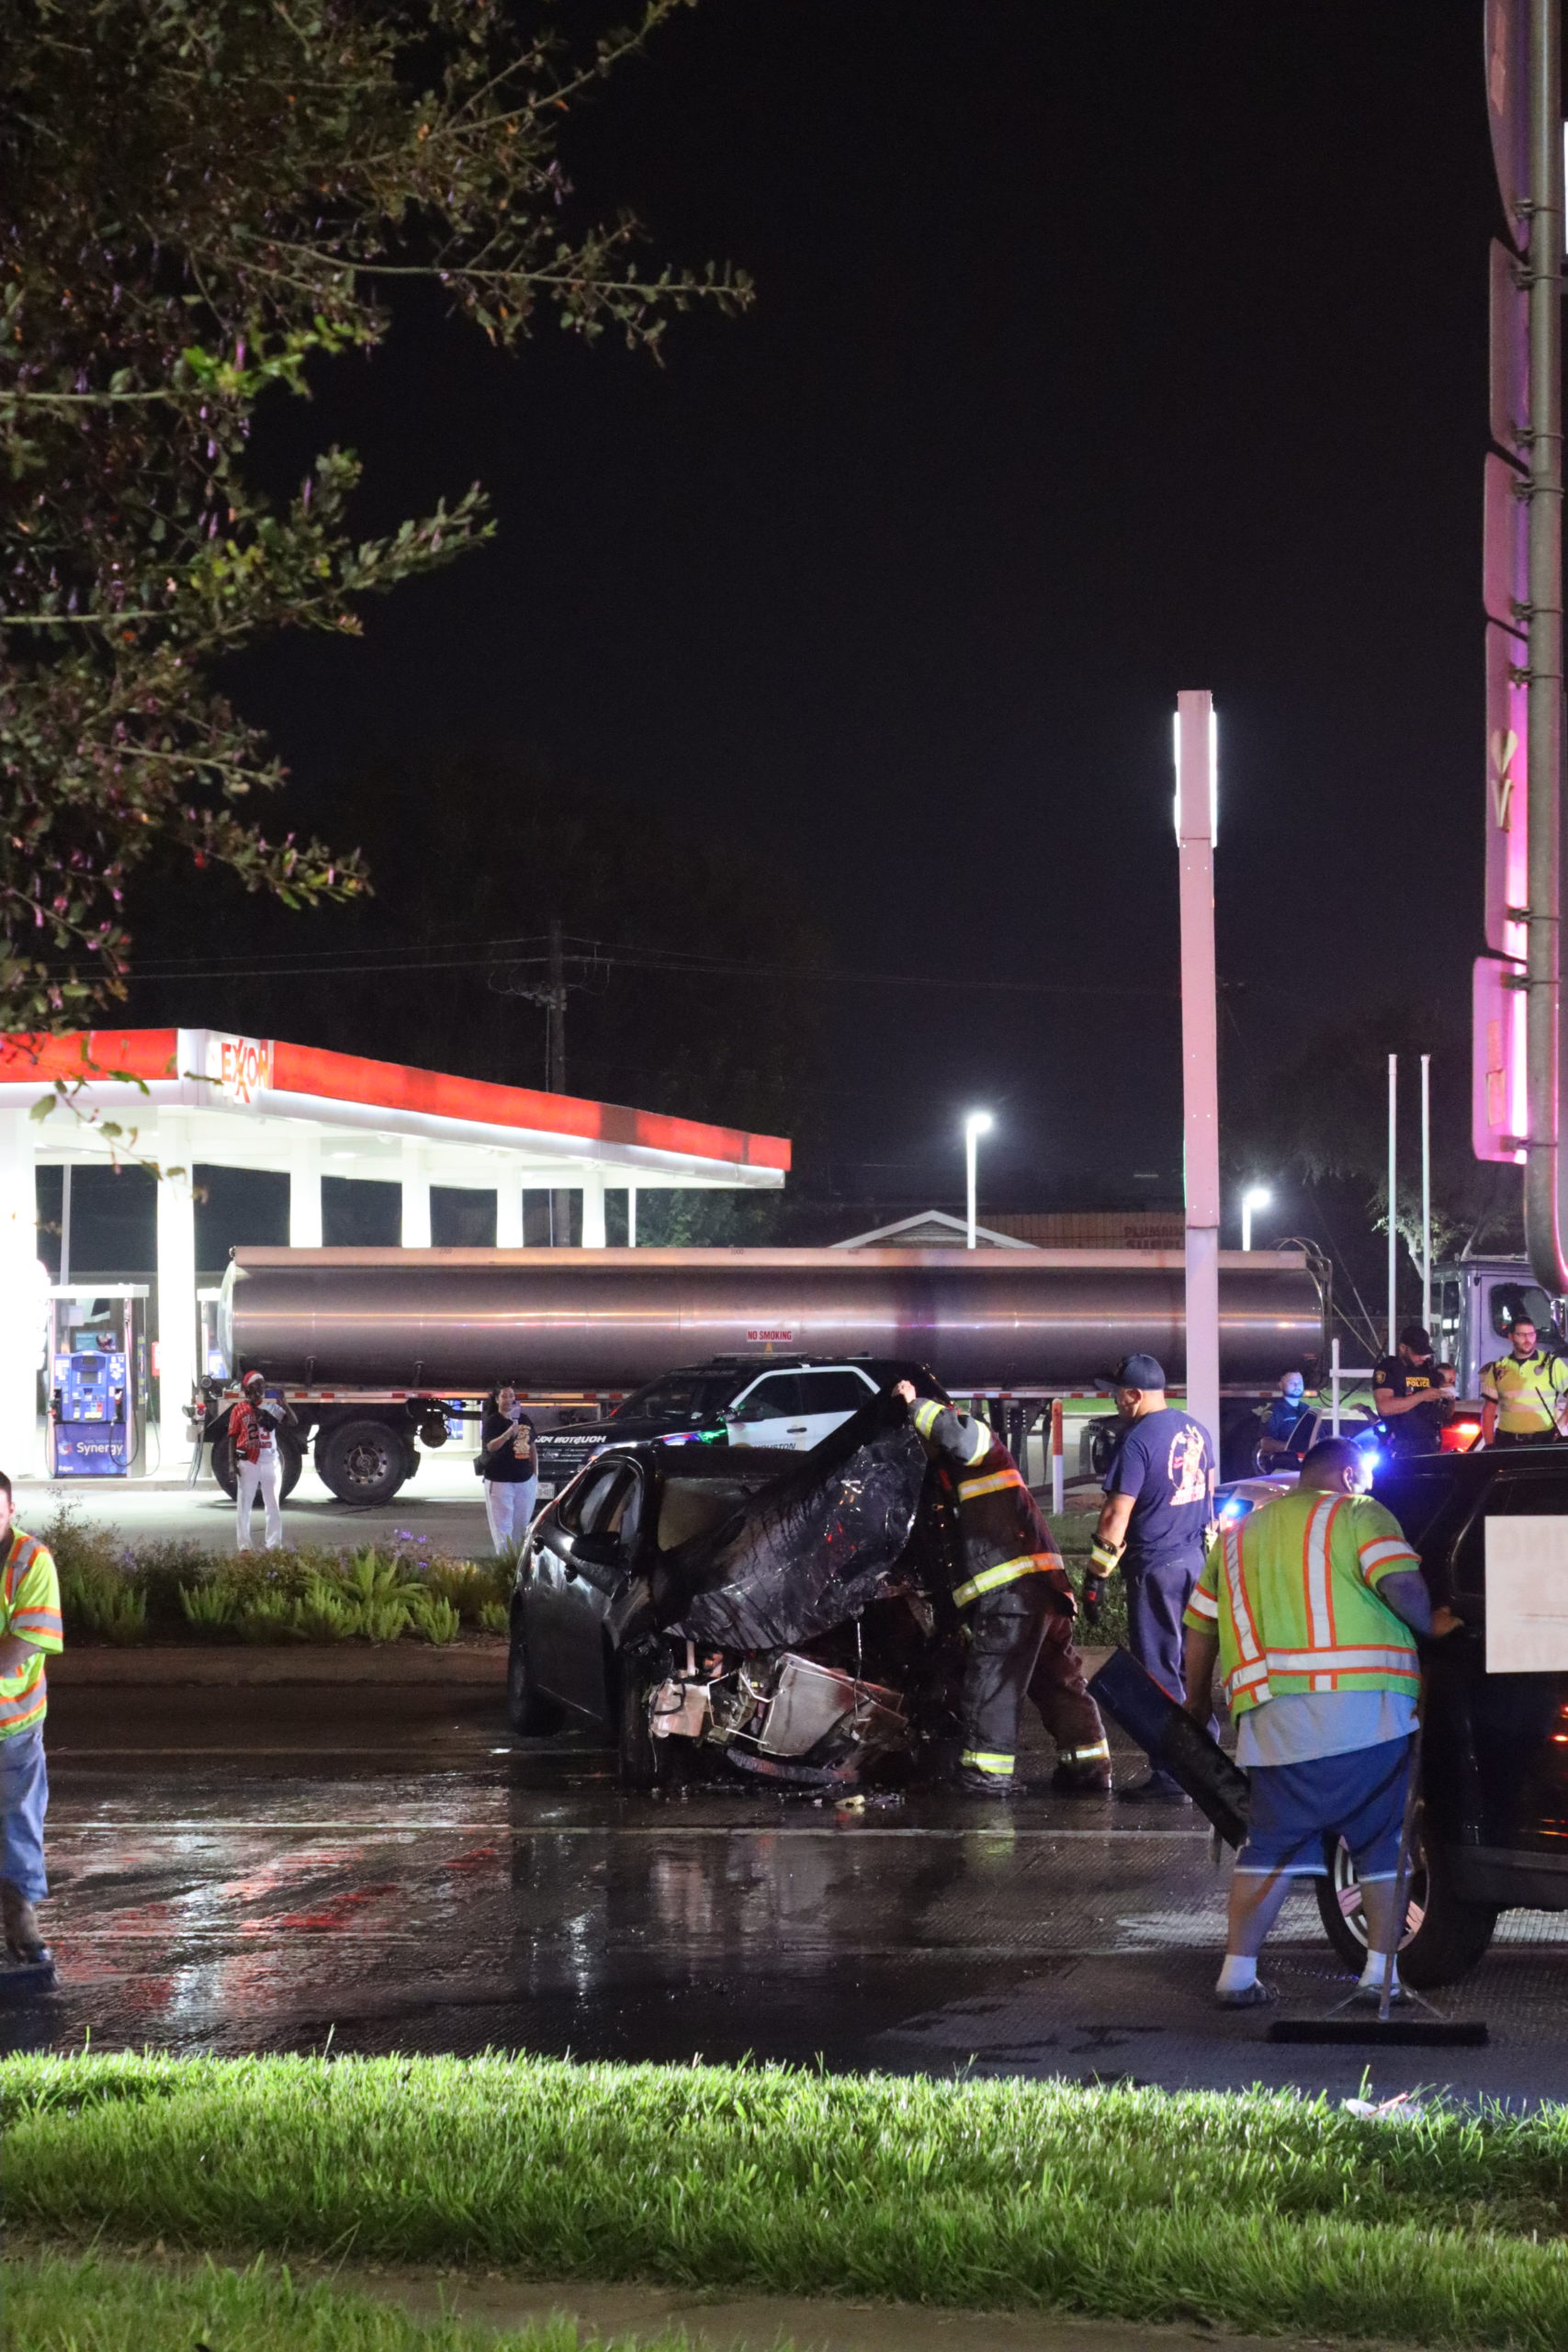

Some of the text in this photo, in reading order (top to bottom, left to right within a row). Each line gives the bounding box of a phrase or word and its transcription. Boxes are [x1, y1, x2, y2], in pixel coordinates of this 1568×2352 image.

[221, 1038, 268, 1103] EXXON
[748, 1330, 792, 1340] NO SMOKING
[76, 1442, 123, 1455] Synergy
